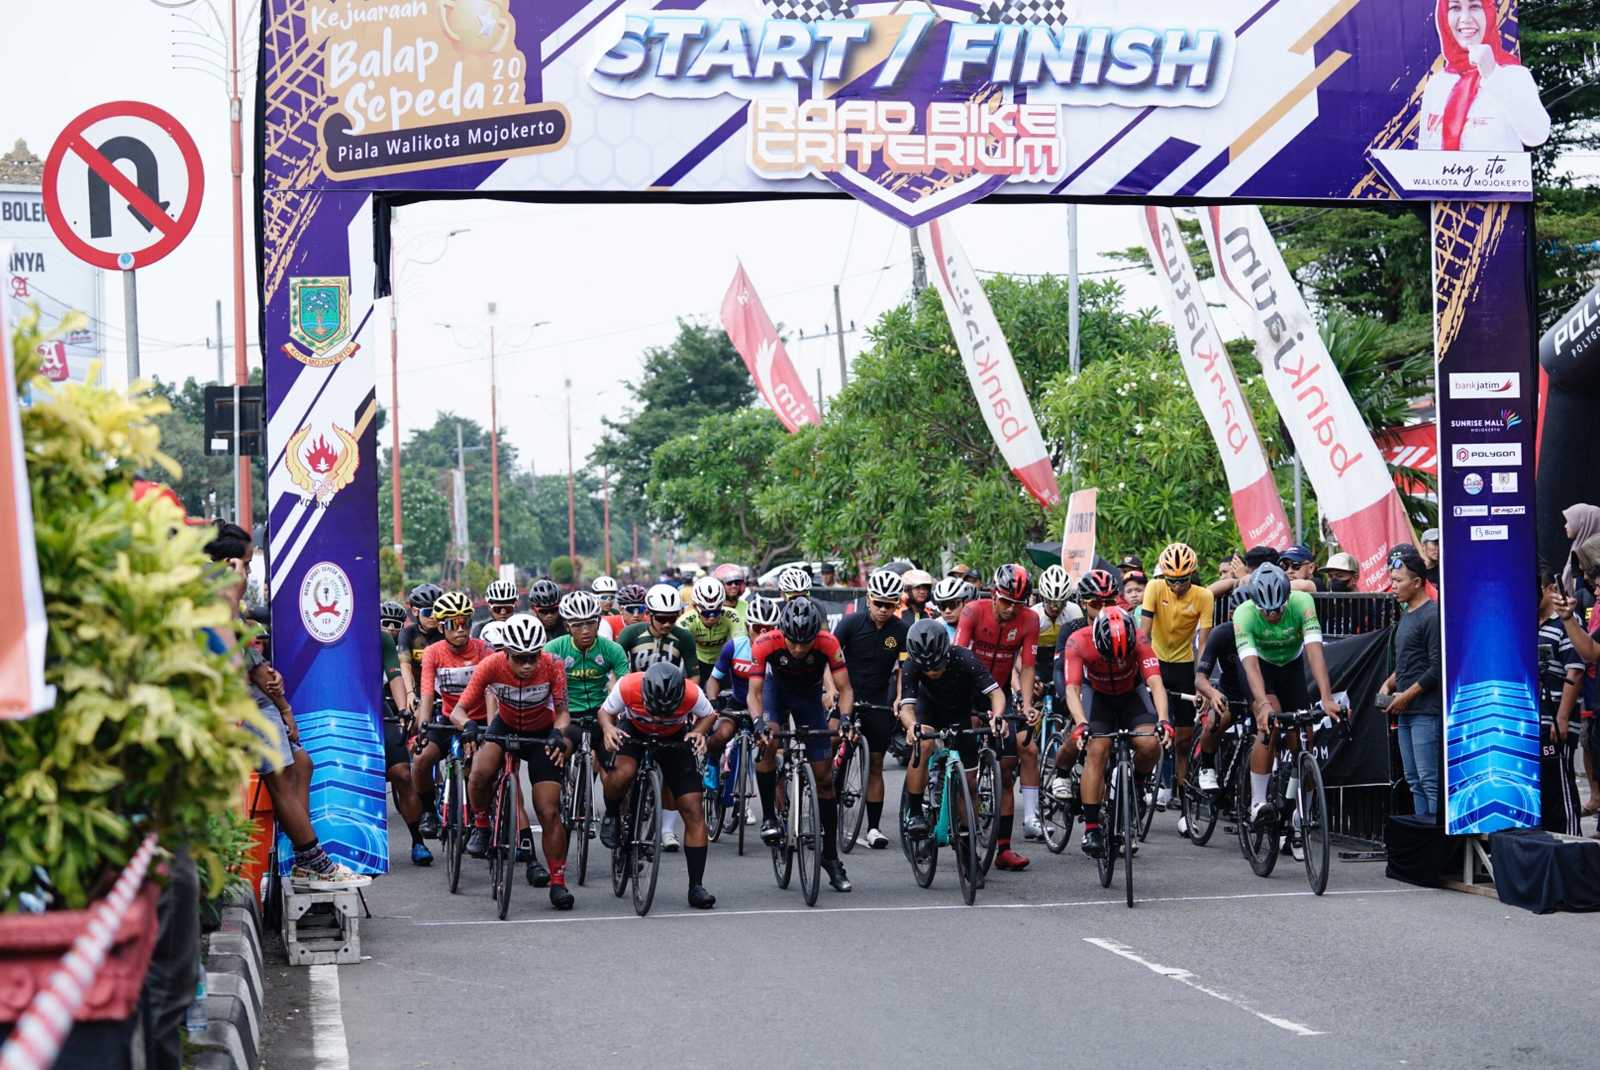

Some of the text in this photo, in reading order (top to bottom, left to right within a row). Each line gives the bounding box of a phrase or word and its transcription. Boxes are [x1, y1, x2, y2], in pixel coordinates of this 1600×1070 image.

[311, 1, 428, 33] Kejuaraan
[329, 27, 440, 89] Balap
[593, 15, 869, 81] START
[942, 23, 1221, 87] FINISH
[492, 57, 521, 80] 20
[342, 62, 485, 136] Sepeda
[492, 82, 520, 106] 22
[757, 101, 1057, 135] ROAD BIKE
[338, 121, 555, 163] Piala Walikota Mojokerto
[756, 133, 1061, 169] CRITERIUM
[1442, 155, 1507, 187] ning ita
[1474, 179, 1529, 187] MOJOKERTO
[1455, 381, 1500, 391] bankjatim
[1485, 419, 1504, 427] MALL
